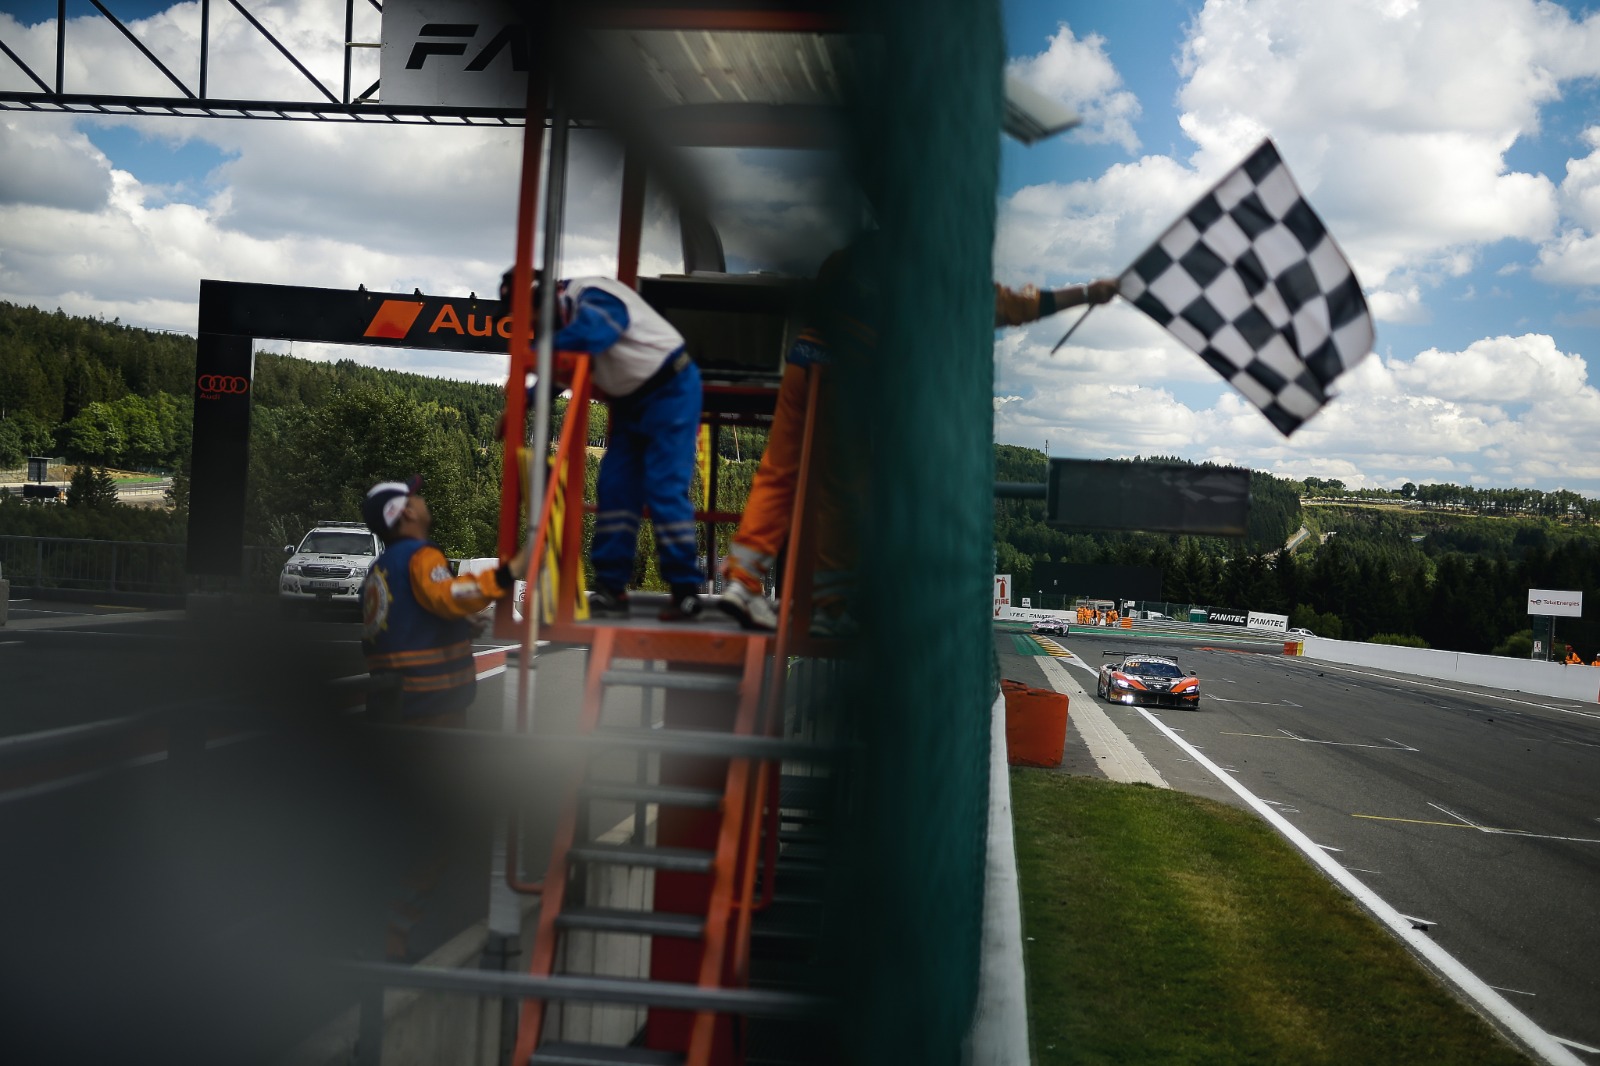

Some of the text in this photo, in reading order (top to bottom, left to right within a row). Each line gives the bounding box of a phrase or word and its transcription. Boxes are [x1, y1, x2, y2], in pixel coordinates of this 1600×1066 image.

[200, 392, 221, 400] Audi
[1543, 599, 1580, 607] TotalEnergies
[1209, 612, 1247, 624] FANATEC
[1249, 617, 1285, 628] FANATEC
